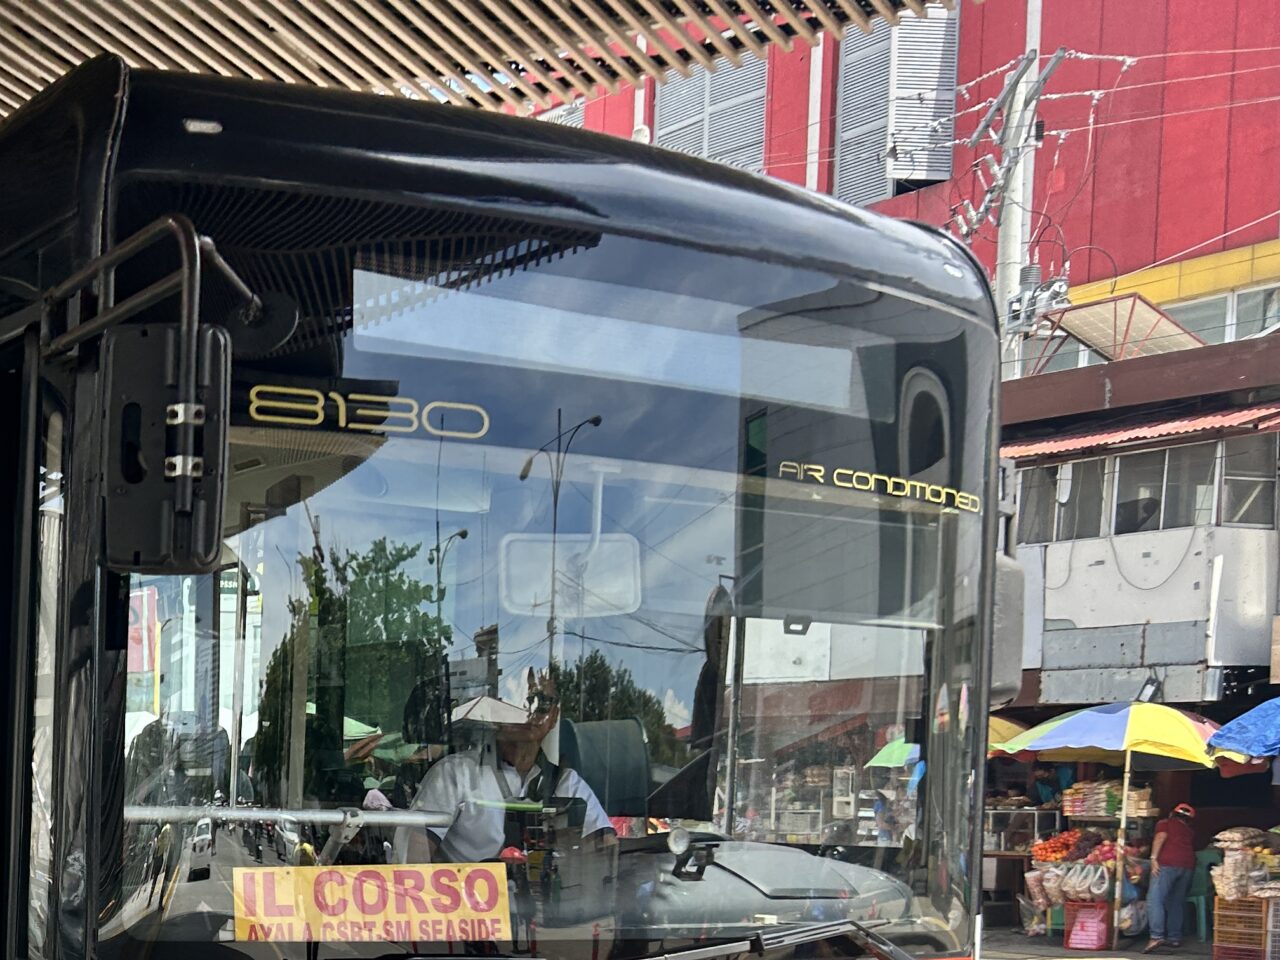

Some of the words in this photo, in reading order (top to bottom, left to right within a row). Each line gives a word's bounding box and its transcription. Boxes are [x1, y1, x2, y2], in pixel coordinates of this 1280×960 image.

[250, 384, 490, 439] 8130
[779, 461, 825, 484] AIR
[833, 468, 981, 513] CONDITIONED
[243, 871, 295, 917] IL
[313, 868, 499, 917] CORSO
[418, 919, 502, 942] SEASIDE
